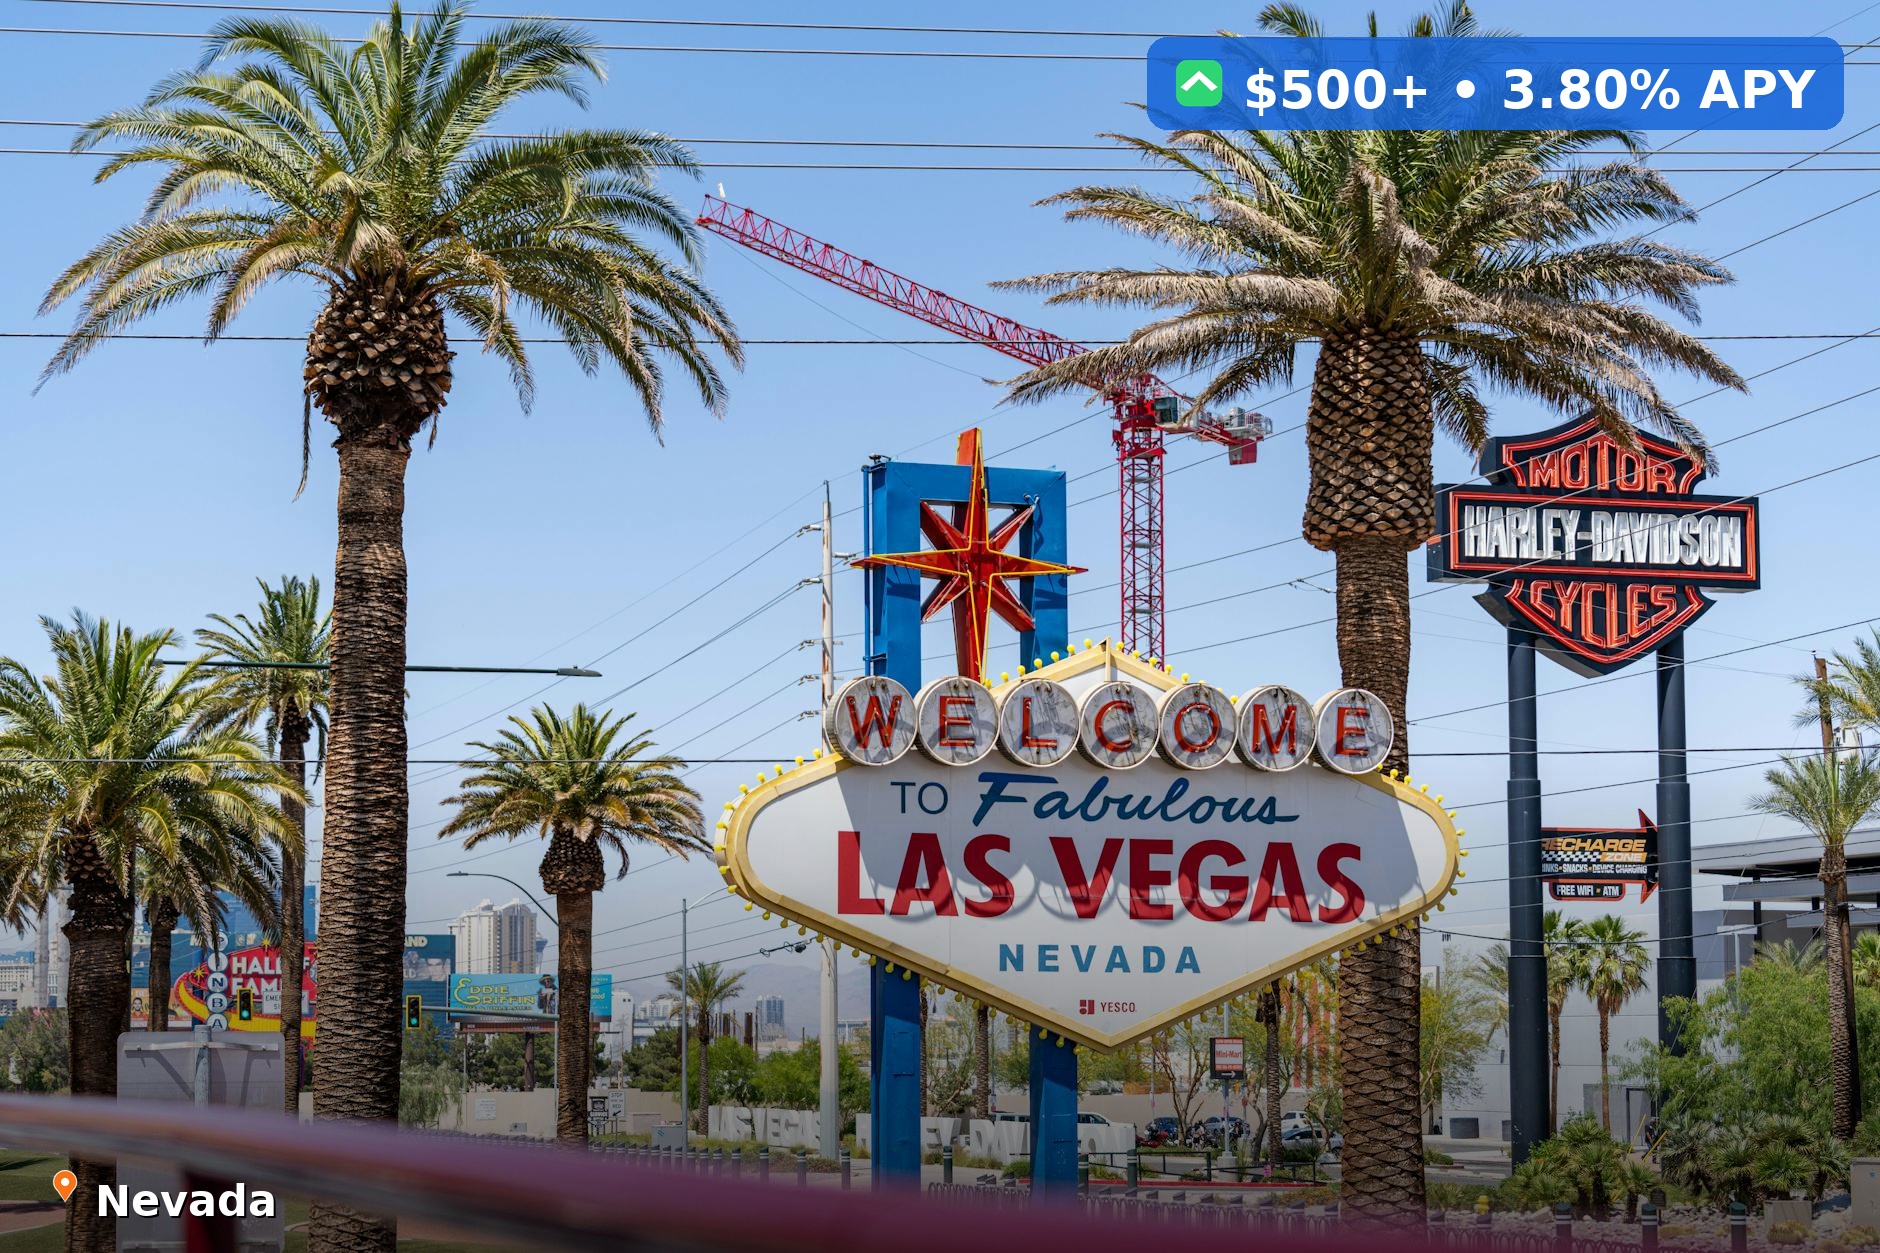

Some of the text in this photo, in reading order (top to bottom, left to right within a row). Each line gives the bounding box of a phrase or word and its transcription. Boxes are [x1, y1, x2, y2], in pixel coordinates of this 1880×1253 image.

[1529, 433, 1676, 494] MOTOR
[1464, 504, 1742, 567] HARLEY-DAVIDSON
[1529, 579, 1677, 649] CYCLES
[845, 694, 1371, 757] WELCOME
[890, 771, 1299, 827] TO Fabulous
[1541, 838, 1646, 852] RECHARGE
[1605, 852, 1643, 862] ZONE
[837, 831, 1366, 924] LAS VEGAS
[1563, 863, 1588, 873] SNACKS
[1592, 864, 1614, 873] DEVICE
[1615, 864, 1648, 874] CHARGING
[1556, 885, 1619, 896] FREE WIFI ATM
[999, 942, 1201, 974] NEVADA
[231, 977, 281, 997] FAM
[454, 977, 509, 994] EDDIE
[456, 994, 536, 1006] GRIFFIN
[1100, 1001, 1136, 1013] YESCO
[708, 1105, 752, 1142] LAS
